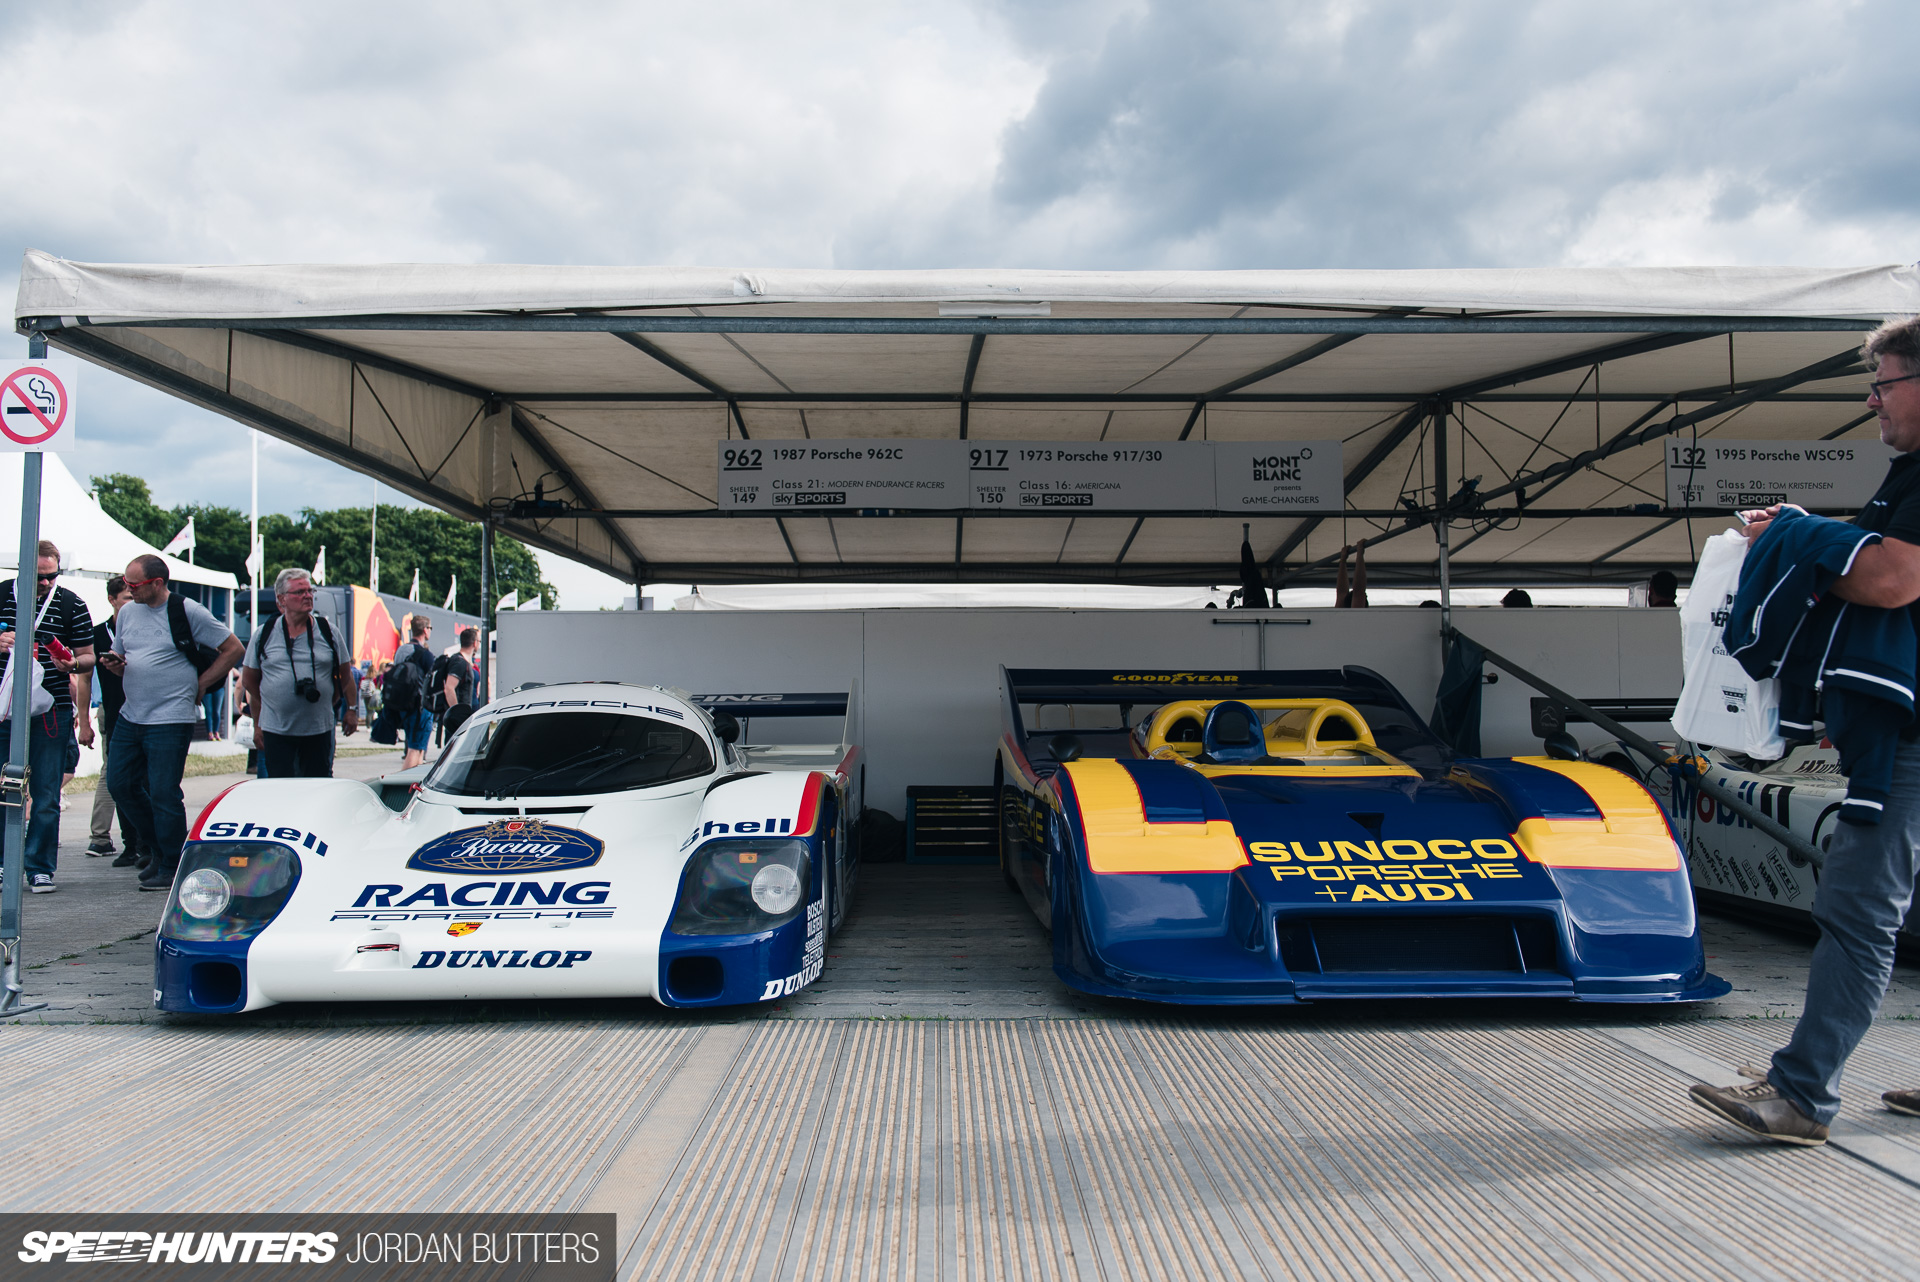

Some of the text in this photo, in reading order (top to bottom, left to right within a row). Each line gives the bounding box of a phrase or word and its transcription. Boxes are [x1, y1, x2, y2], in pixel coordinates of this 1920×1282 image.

[724, 448, 763, 467] 962
[772, 449, 904, 461] 1987 Porsche 962C
[969, 449, 1009, 467] 917
[1019, 450, 1163, 463] 1973 Porsche 917/30
[1671, 447, 1706, 466] 132
[1715, 449, 1854, 461] 1995 Porsche WSC95
[1252, 456, 1301, 469] MONT
[1252, 468, 1302, 481] BLANC
[772, 479, 945, 489] Class 21: MODERN ENDURANCE RACERS
[1019, 480, 1121, 490] Class 16: AMERICANA
[1716, 479, 1834, 490] Class 20: TOM KRISTENSEN
[733, 492, 757, 504] 149
[774, 493, 845, 505] sky SPORTS
[979, 492, 1004, 504] 150
[1022, 493, 1091, 505] sky SPORTS
[1241, 496, 1320, 505] GAME-CHANGERS
[1681, 491, 1702, 503] 151
[1719, 493, 1785, 505] sky SPORTS
[1112, 673, 1239, 684] GOODYEAR
[474, 699, 684, 722] PORSCHE
[1792, 758, 1842, 775] FATurb
[1671, 774, 1759, 829] Mobil
[206, 822, 329, 858] Shell
[679, 818, 791, 852] Shell
[450, 837, 565, 859] Racing
[1249, 838, 1519, 862] SUNOCO
[1269, 863, 1524, 882] PORSCHE
[1770, 854, 1797, 893] HAZET
[351, 881, 612, 908] RACING
[807, 898, 823, 921] BOSCH
[329, 911, 615, 922] PORSCHE
[411, 950, 593, 969] DUNLOP
[759, 957, 824, 1001] DUNLOP
